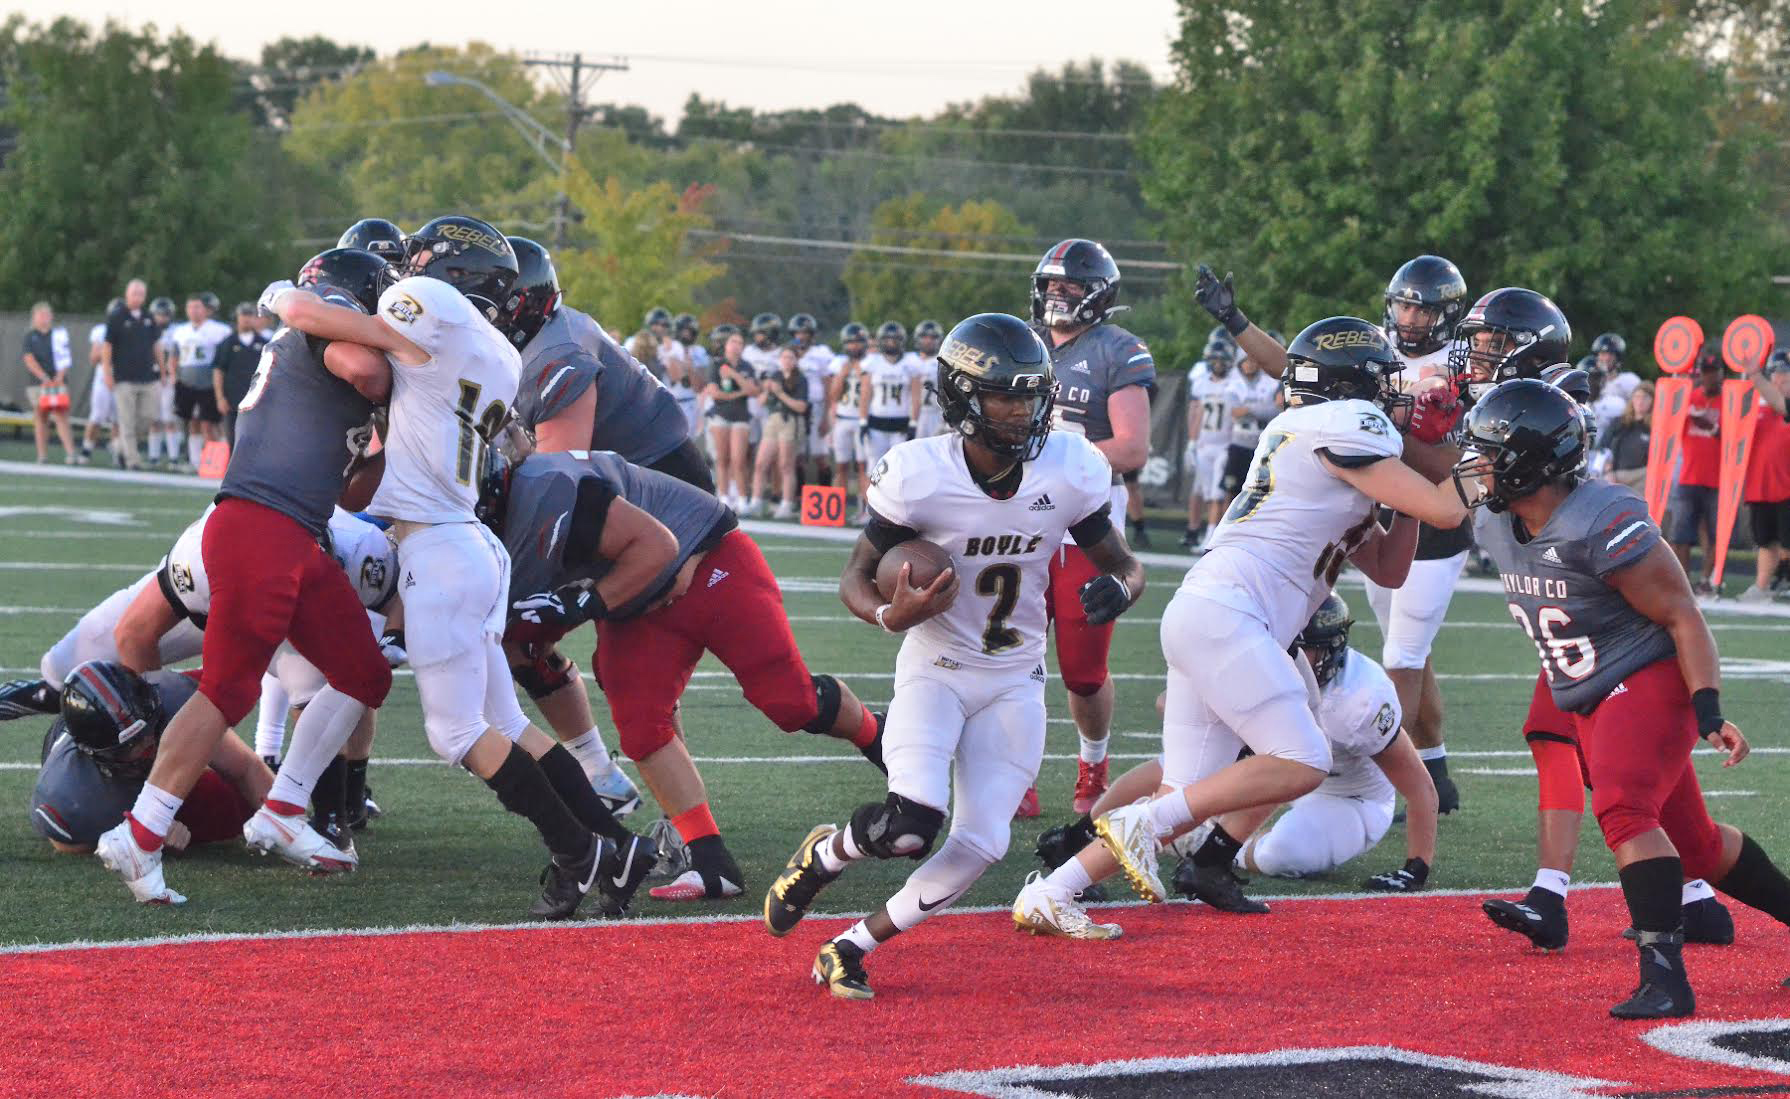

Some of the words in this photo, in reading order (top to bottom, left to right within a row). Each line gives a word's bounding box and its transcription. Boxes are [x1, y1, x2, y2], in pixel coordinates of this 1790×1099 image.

[881, 382, 904, 405] 14
[1068, 386, 1090, 403] CO
[1204, 402, 1224, 430] 21
[807, 491, 842, 521] 30
[1028, 504, 1056, 512] adidas
[963, 534, 1043, 557] BOYLE
[1545, 579, 1567, 599] CO
[975, 562, 1024, 656] 2
